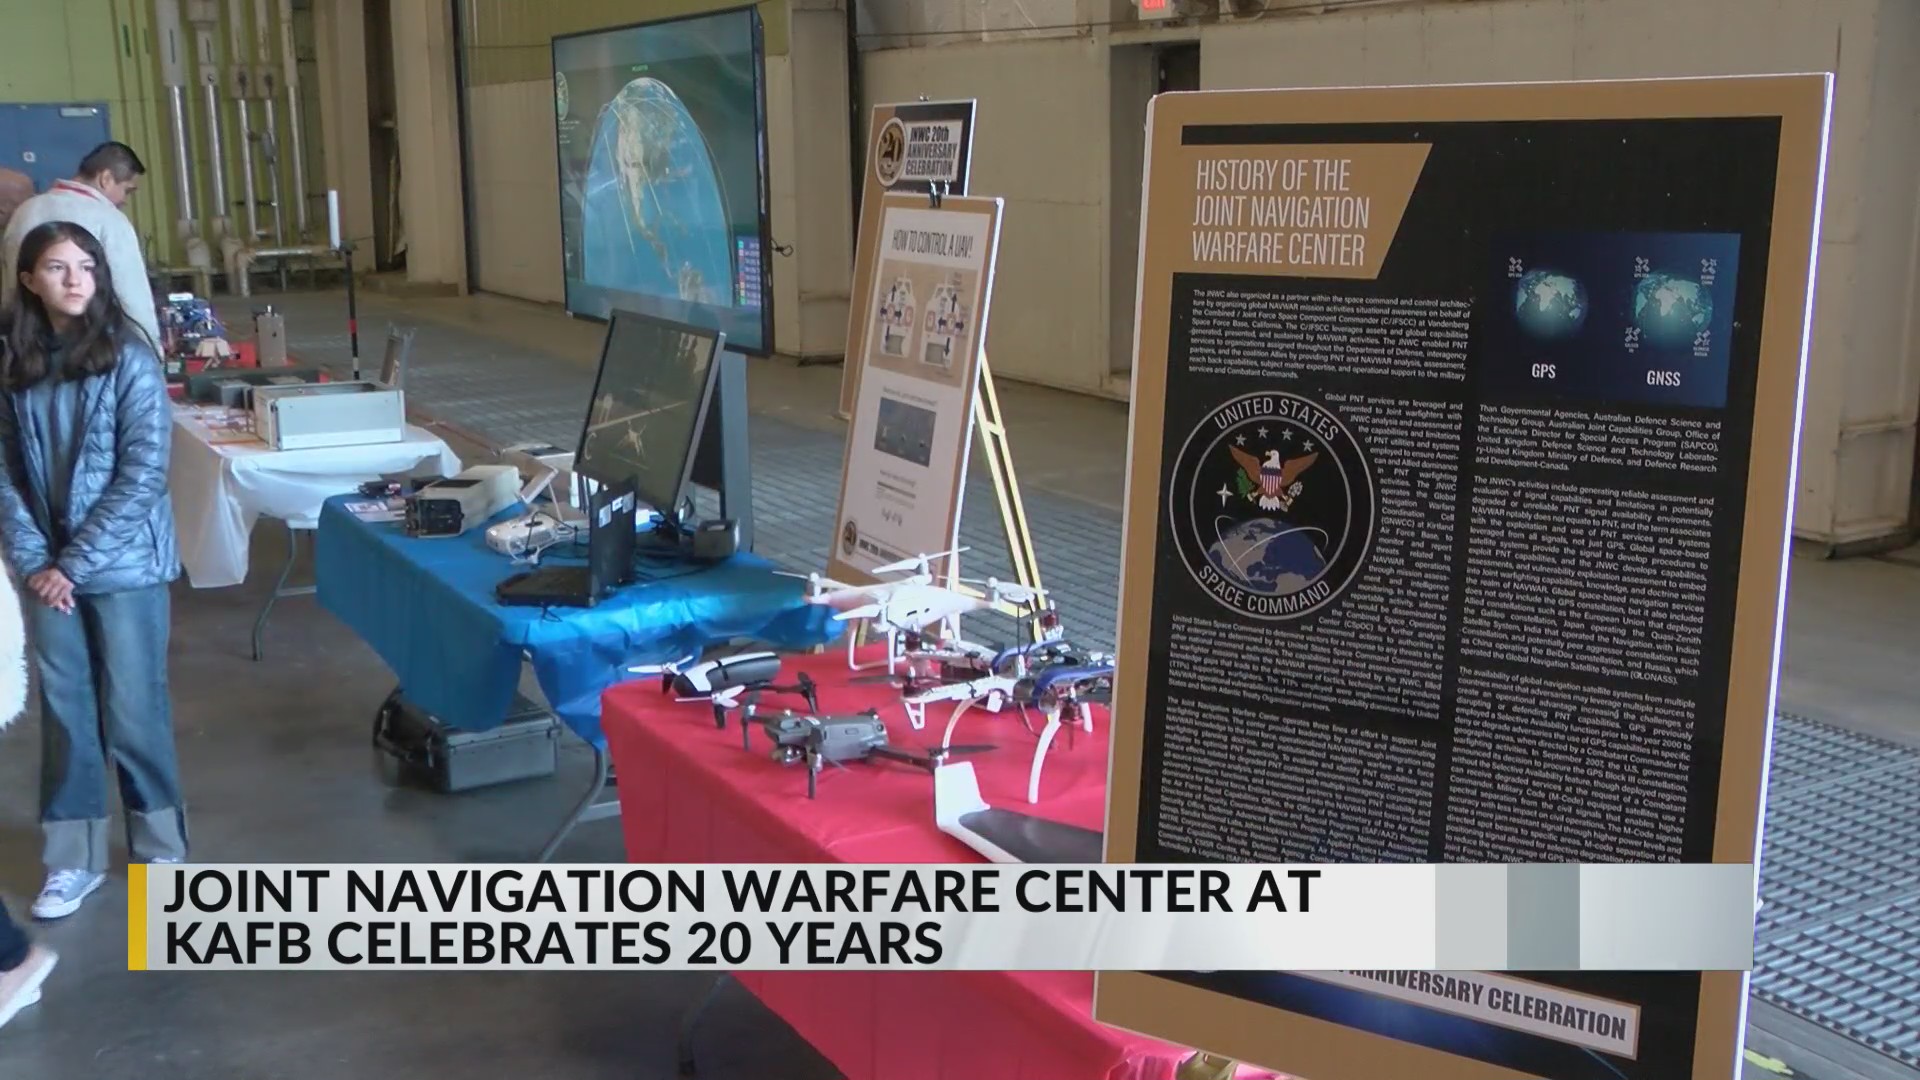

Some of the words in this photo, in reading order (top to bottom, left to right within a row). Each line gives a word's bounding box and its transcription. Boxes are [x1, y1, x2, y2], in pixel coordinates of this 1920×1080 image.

[931, 125, 949, 142] 20th
[907, 143, 957, 160] ANNIVERSARY
[905, 160, 953, 176] CELEBRATION
[1197, 159, 1278, 191] HISTORY
[1282, 159, 1308, 191] OF
[1313, 159, 1351, 191] THE
[1193, 195, 1247, 227] JOINT
[1251, 196, 1370, 229] NAVIGATION
[917, 231, 947, 256] CONTROL
[1192, 231, 1284, 264] WARFARE
[1289, 233, 1365, 266] CENTER
[1531, 363, 1556, 379] GPS
[1647, 370, 1681, 387] GNSS
[1214, 397, 1274, 430] UNITED
[1279, 399, 1339, 442] STATES
[1199, 564, 1245, 607] SPACE
[1247, 580, 1331, 614] COMMAND
[1349, 970, 1484, 1006] NIVERSARY
[1487, 987, 1627, 1041] CELEBRATION
